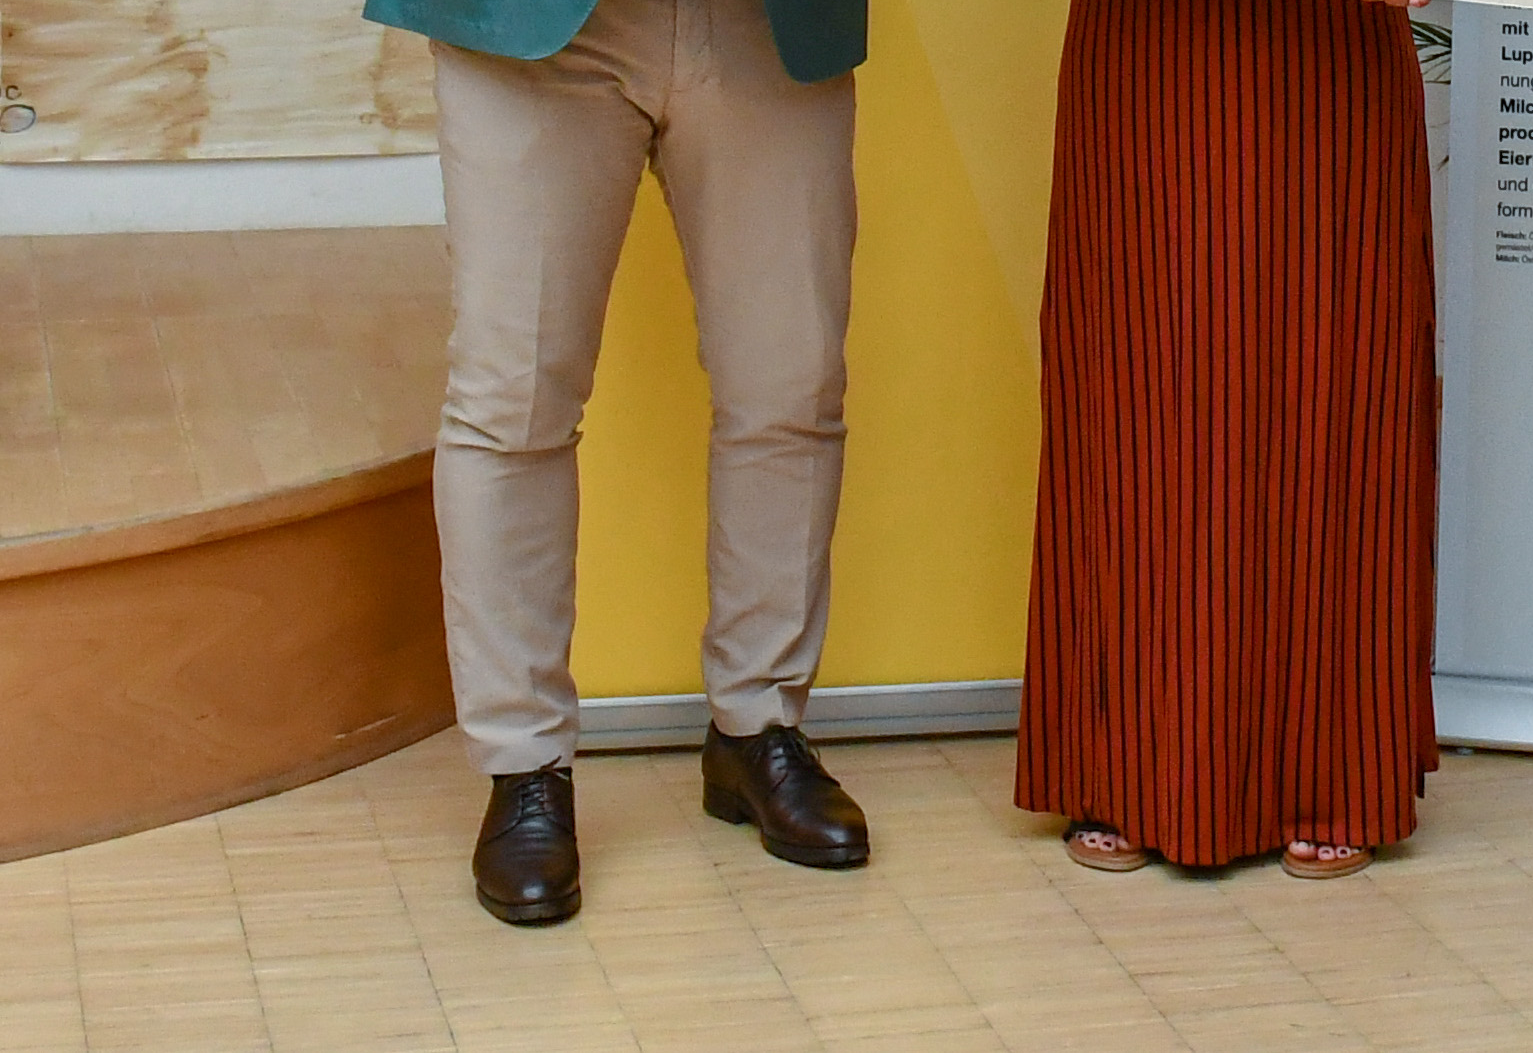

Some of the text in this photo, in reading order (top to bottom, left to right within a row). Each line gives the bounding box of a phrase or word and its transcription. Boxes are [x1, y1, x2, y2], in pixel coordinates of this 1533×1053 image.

[1502, 20, 1529, 36] mit
[1498, 177, 1528, 192] und
[1497, 201, 1533, 218] form
